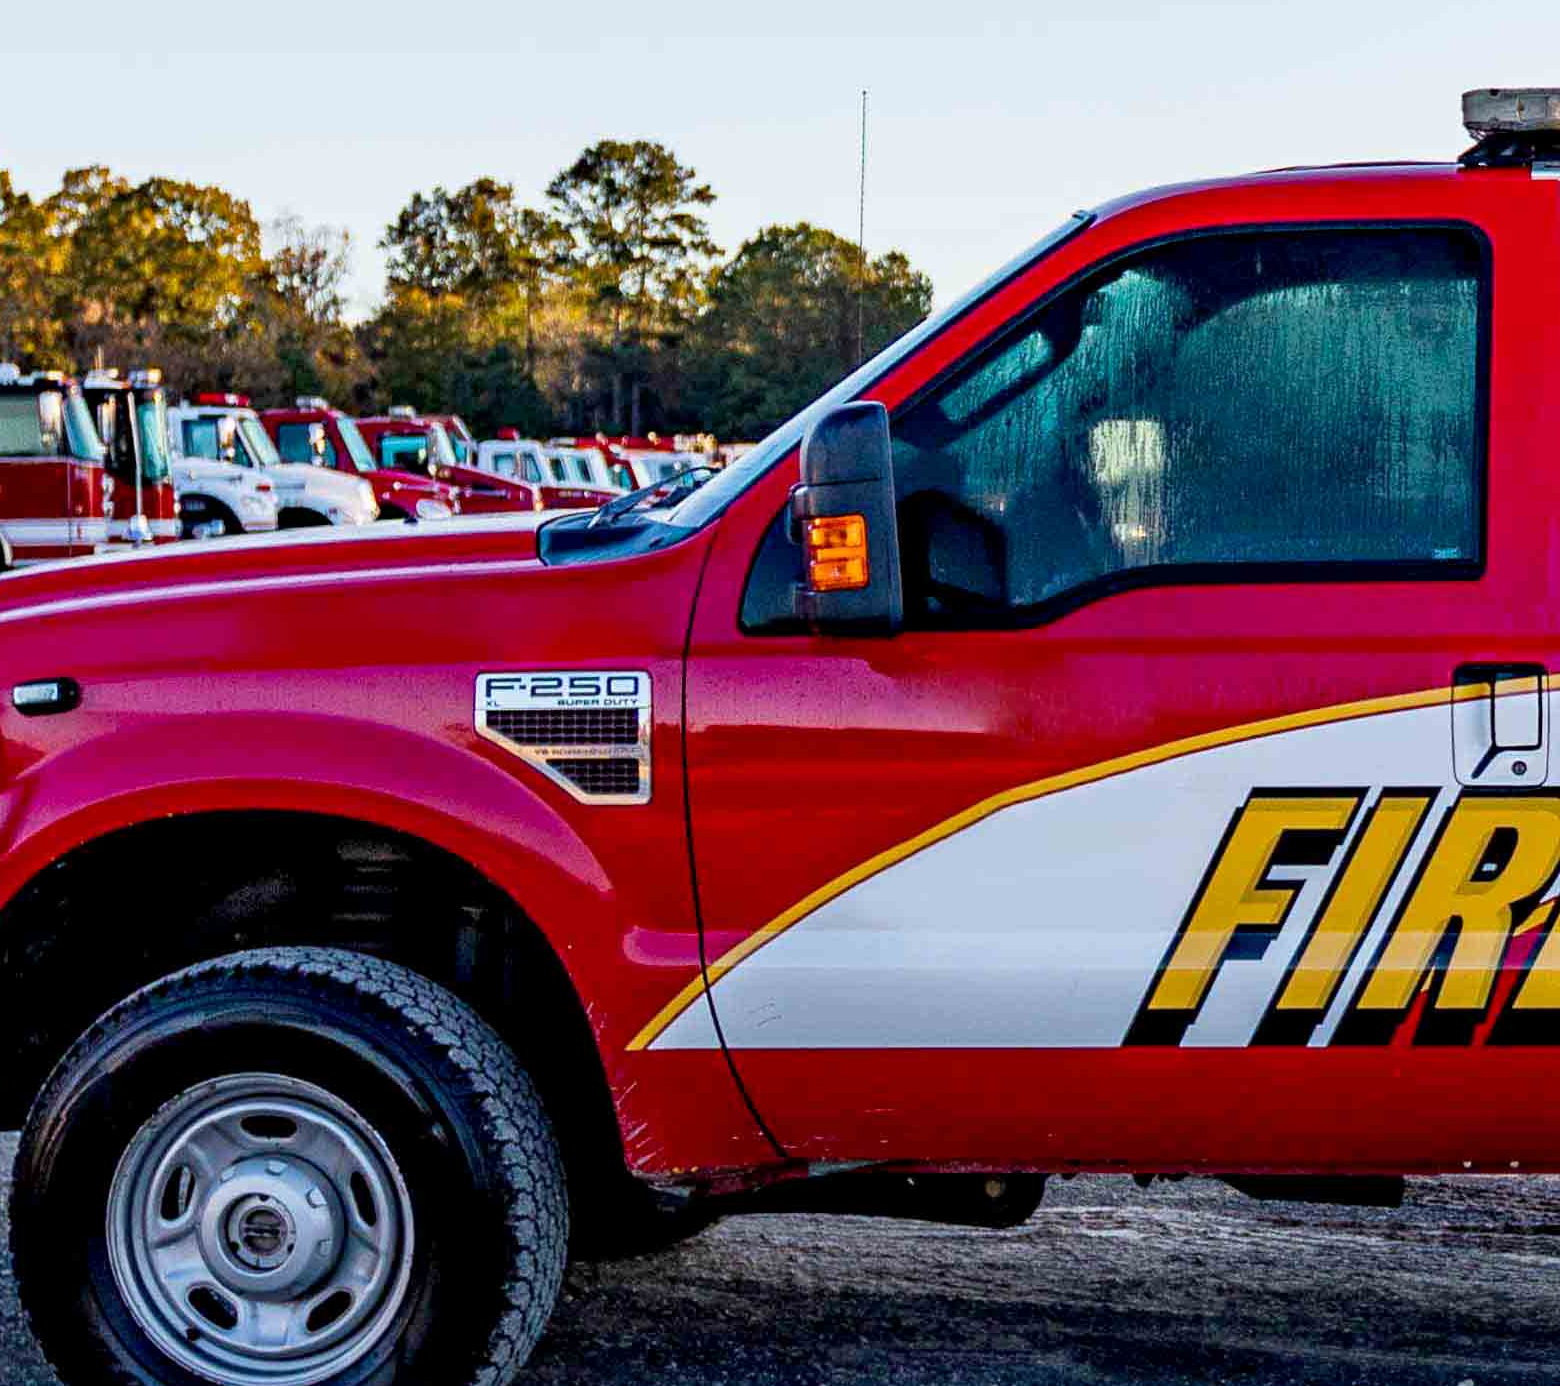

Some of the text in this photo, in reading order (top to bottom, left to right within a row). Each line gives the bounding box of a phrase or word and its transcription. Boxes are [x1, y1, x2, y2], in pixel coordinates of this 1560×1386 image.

[486, 676, 639, 698] F-250
[557, 698, 639, 707] SUPER DUTY
